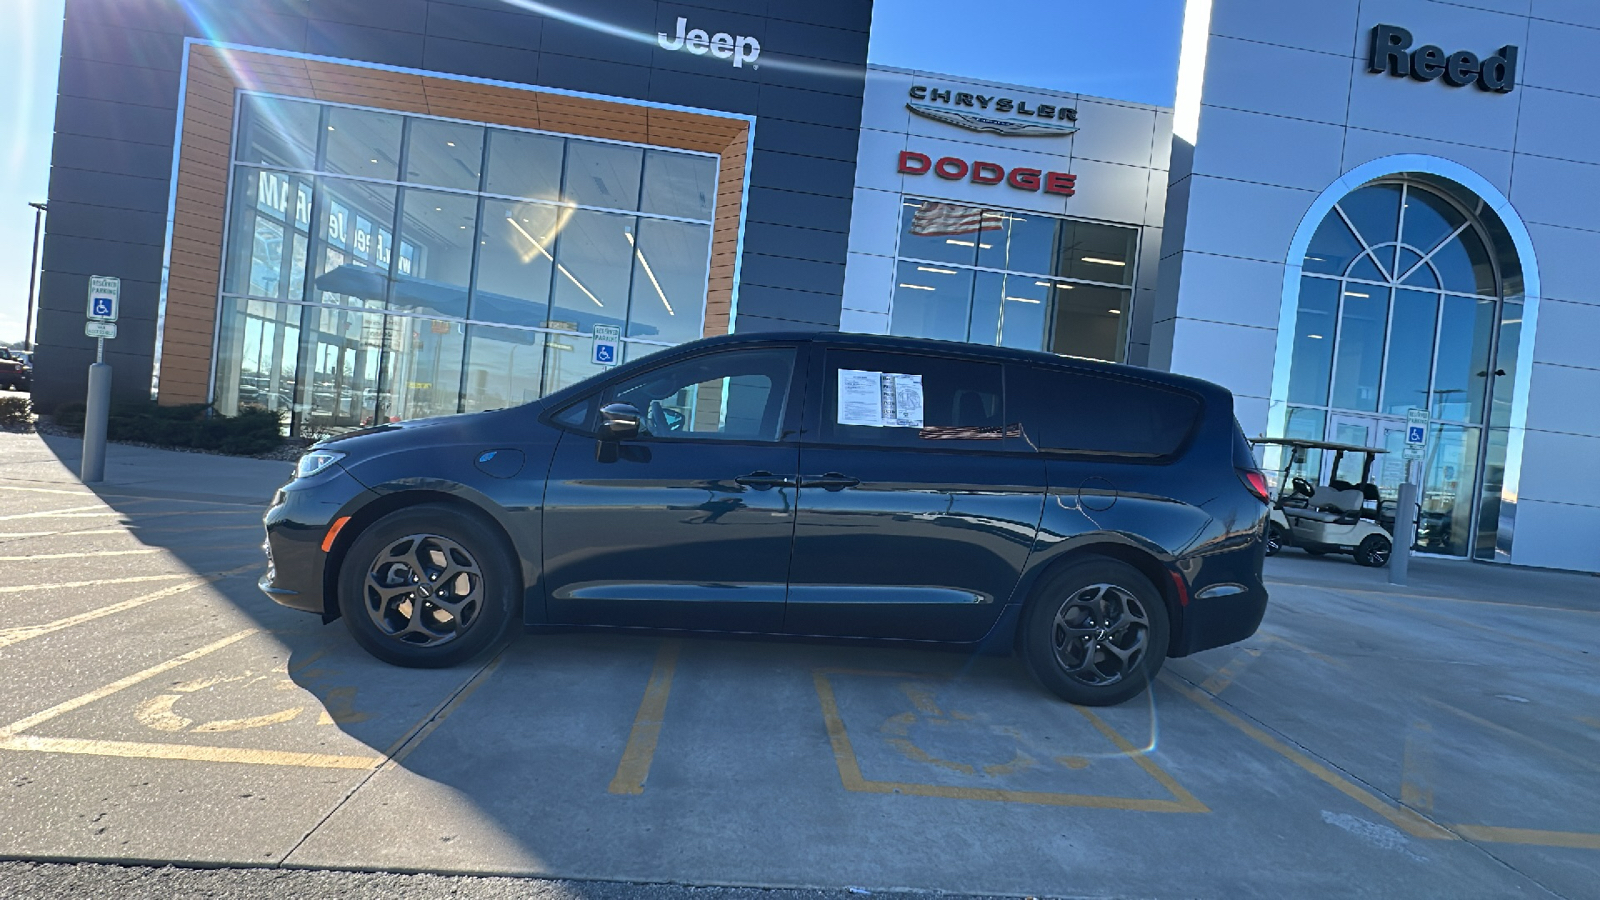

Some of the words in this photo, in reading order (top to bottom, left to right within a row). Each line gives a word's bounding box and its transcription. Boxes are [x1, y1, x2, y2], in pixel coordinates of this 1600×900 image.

[658, 16, 761, 68] Jeep
[1368, 23, 1519, 93] Reed
[909, 86, 1078, 121] CHRYSLER
[898, 150, 1077, 197] DODGE
